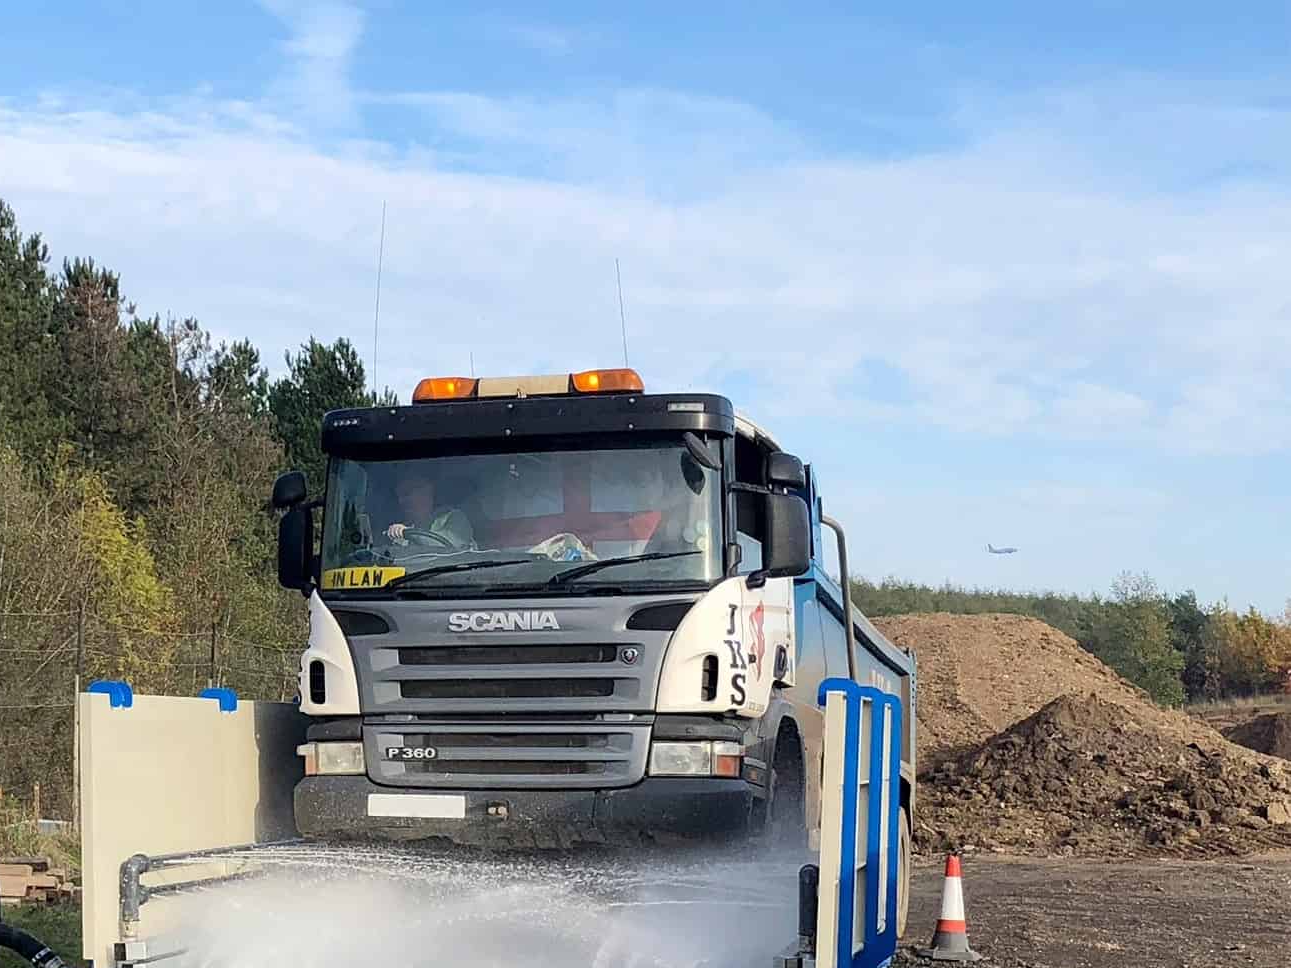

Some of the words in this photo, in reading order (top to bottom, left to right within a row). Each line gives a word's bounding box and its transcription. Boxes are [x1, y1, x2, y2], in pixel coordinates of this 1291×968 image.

[333, 571, 345, 587] IN
[350, 570, 383, 586] LAW
[448, 610, 560, 632] SCANIA
[388, 748, 402, 759] P
[402, 747, 436, 759] 360
